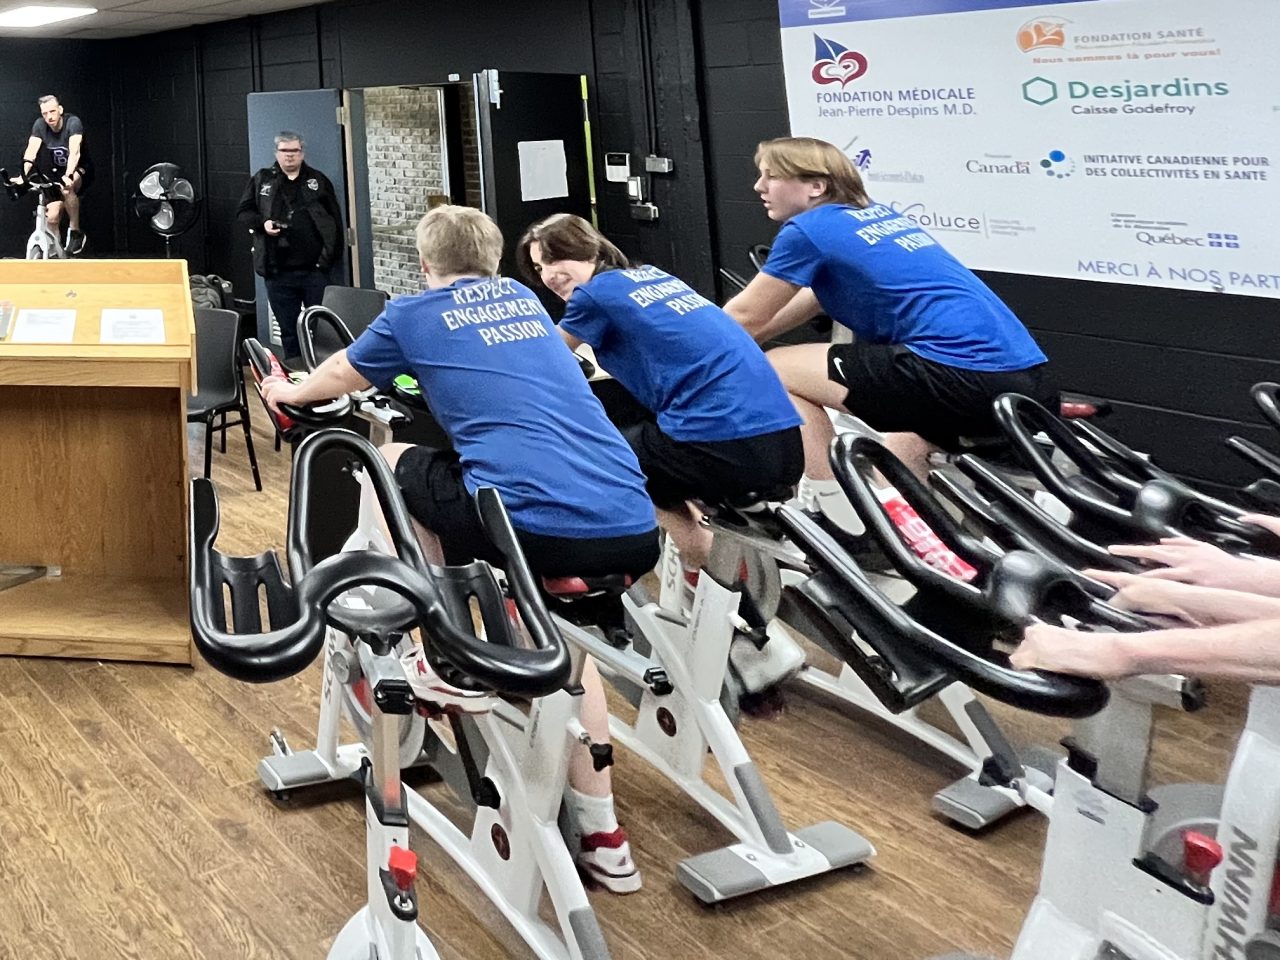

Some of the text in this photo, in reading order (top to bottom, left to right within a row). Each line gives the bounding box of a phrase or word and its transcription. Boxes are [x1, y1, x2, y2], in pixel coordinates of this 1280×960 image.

[1073, 27, 1206, 44] FONDATION SANTÉ
[816, 87, 976, 104] FONDATION MÉDICALE
[1067, 77, 1230, 102] Desjardins
[818, 103, 977, 119] Jean-Pierre Despins M.D.
[1071, 102, 1196, 116] Caisse Godefroy
[965, 159, 1031, 175] Canada
[1083, 154, 1270, 167] INITIATIVE CANADIENNE POUR
[1085, 167, 1107, 177] DES
[1204, 169, 1221, 180] EN
[907, 211, 981, 230] soluce
[1135, 231, 1206, 247] Québec
[1077, 259, 1139, 277] MERCI
[1146, 261, 1162, 279] À
[1168, 266, 1222, 286] NOS
[477, 319, 550, 347] PASSION
[1211, 825, 1259, 960] HWINN
